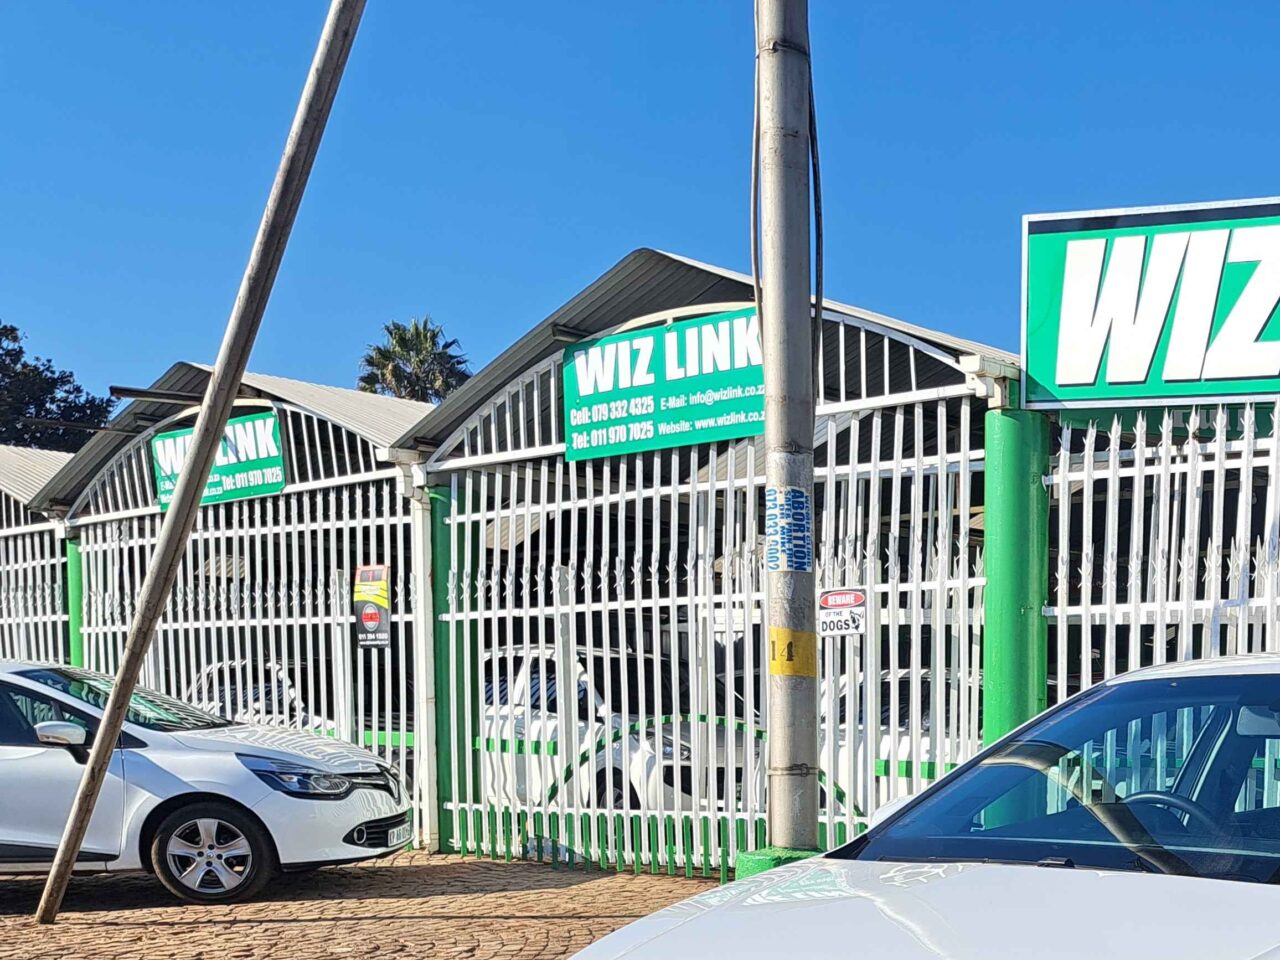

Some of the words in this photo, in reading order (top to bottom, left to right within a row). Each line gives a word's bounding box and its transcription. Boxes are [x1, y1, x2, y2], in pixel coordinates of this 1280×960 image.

[574, 336, 655, 397] WIZ
[664, 315, 763, 381] LINK
[570, 407, 591, 426] Cell:
[592, 403, 608, 422] 079
[609, 399, 628, 419] 332
[629, 395, 654, 416] 4325
[660, 394, 687, 410] E-Mail:
[572, 431, 590, 450] Tel:
[591, 428, 607, 447] 011
[608, 424, 627, 444] 970
[628, 420, 654, 441] 7025
[658, 420, 692, 435] Website:
[695, 410, 765, 430] www.wizlink.co.z
[791, 489, 807, 571] ABORTION
[821, 619, 850, 632] DOGS
